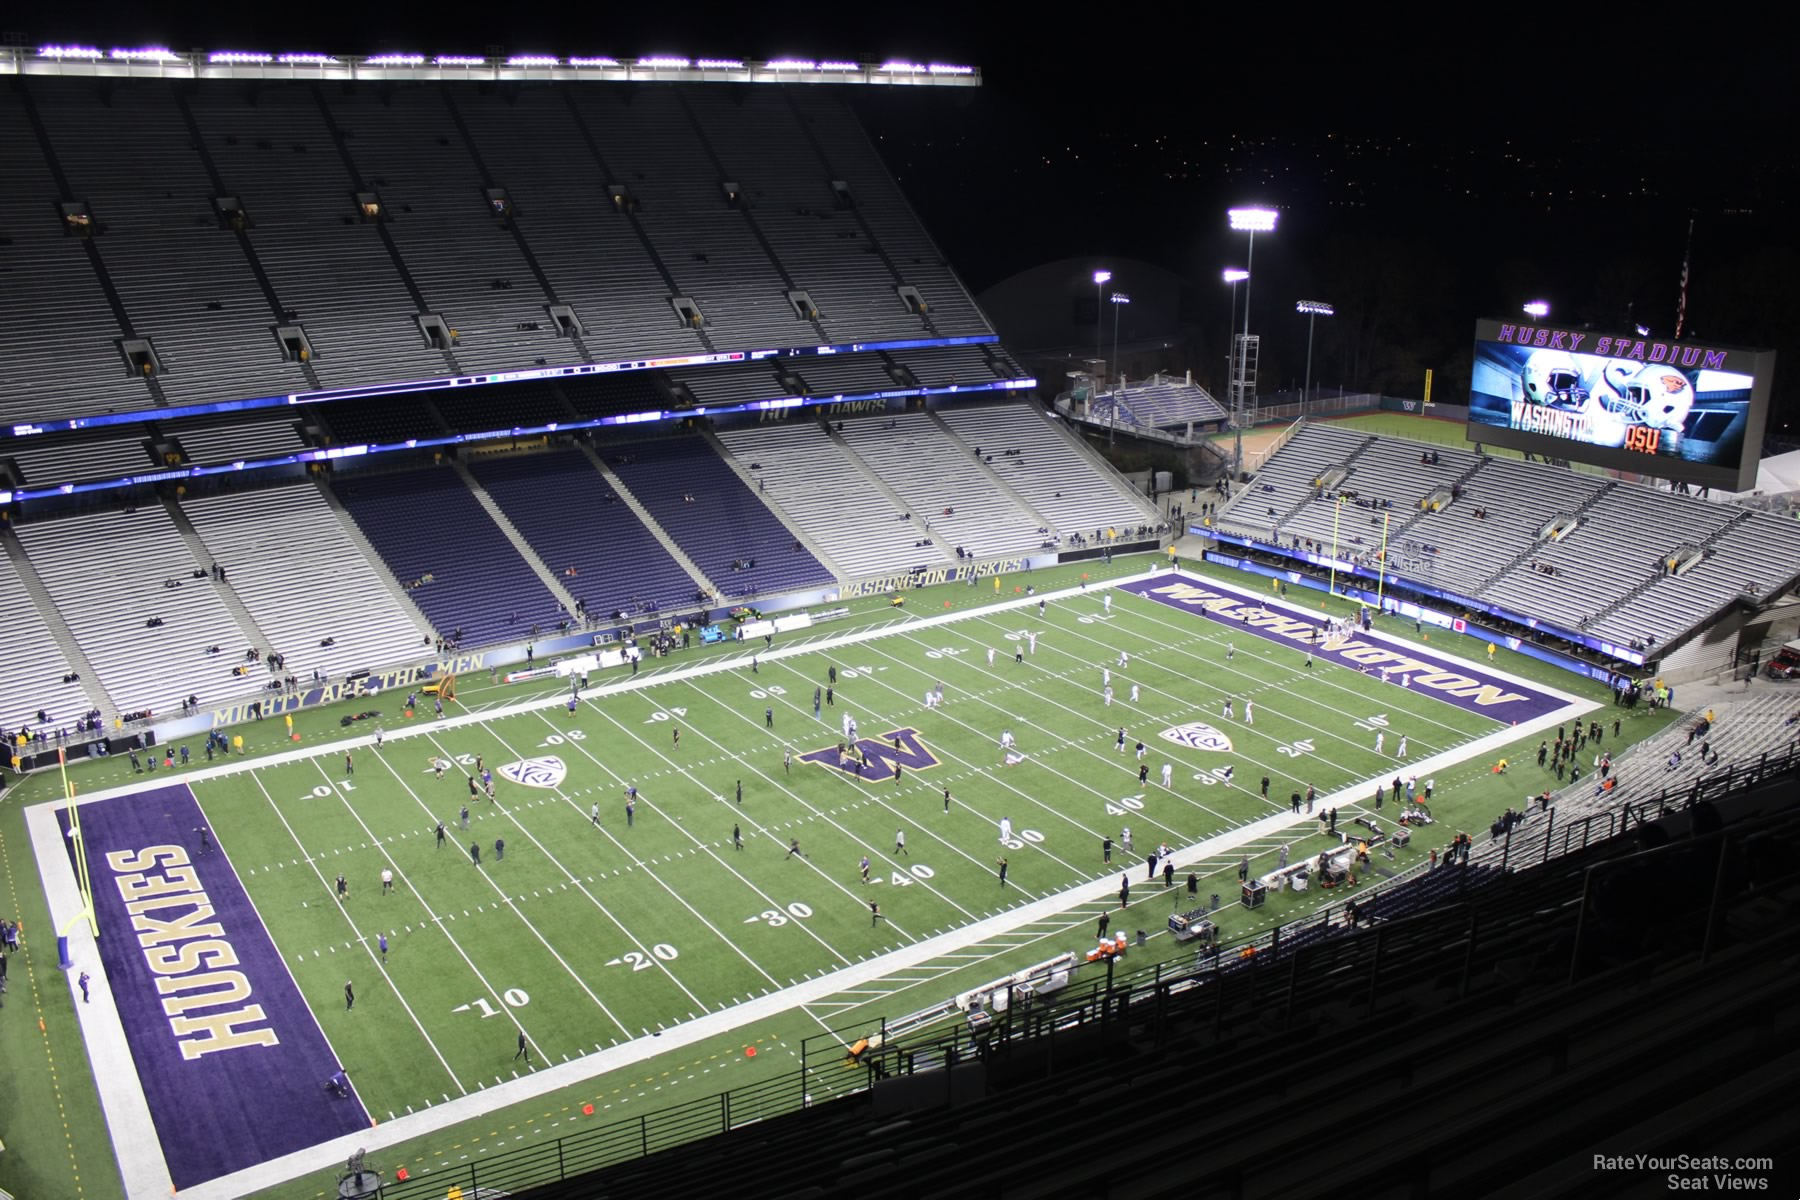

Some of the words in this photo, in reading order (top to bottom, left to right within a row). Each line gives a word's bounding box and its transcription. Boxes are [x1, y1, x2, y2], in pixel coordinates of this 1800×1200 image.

[1498, 324, 1585, 350] HUSKY
[1595, 337, 1727, 369] STADIUM
[830, 398, 887, 414] DAWGS
[1511, 401, 1593, 433] WASHINGTON
[1625, 425, 1660, 450] OSU
[1390, 554, 1432, 573] Allstate
[840, 568, 947, 600] WASHINGTON
[955, 558, 1022, 581] HUSKIES
[1150, 582, 1530, 706] WASHINGTON
[212, 690, 311, 727] MIGHTY
[320, 677, 369, 703] ARE
[437, 653, 484, 677] MEN
[750, 685, 787, 699] 50
[1353, 714, 1389, 732] 10
[546, 729, 587, 746] 30
[1276, 740, 1316, 758] 20
[793, 726, 943, 783] W
[313, 779, 356, 798] 10
[1104, 796, 1145, 816] 40
[891, 864, 935, 887] 40
[760, 902, 813, 927] 30
[105, 844, 280, 1061] HUSKIES
[623, 943, 679, 972] 20
[472, 988, 530, 1019] 10
